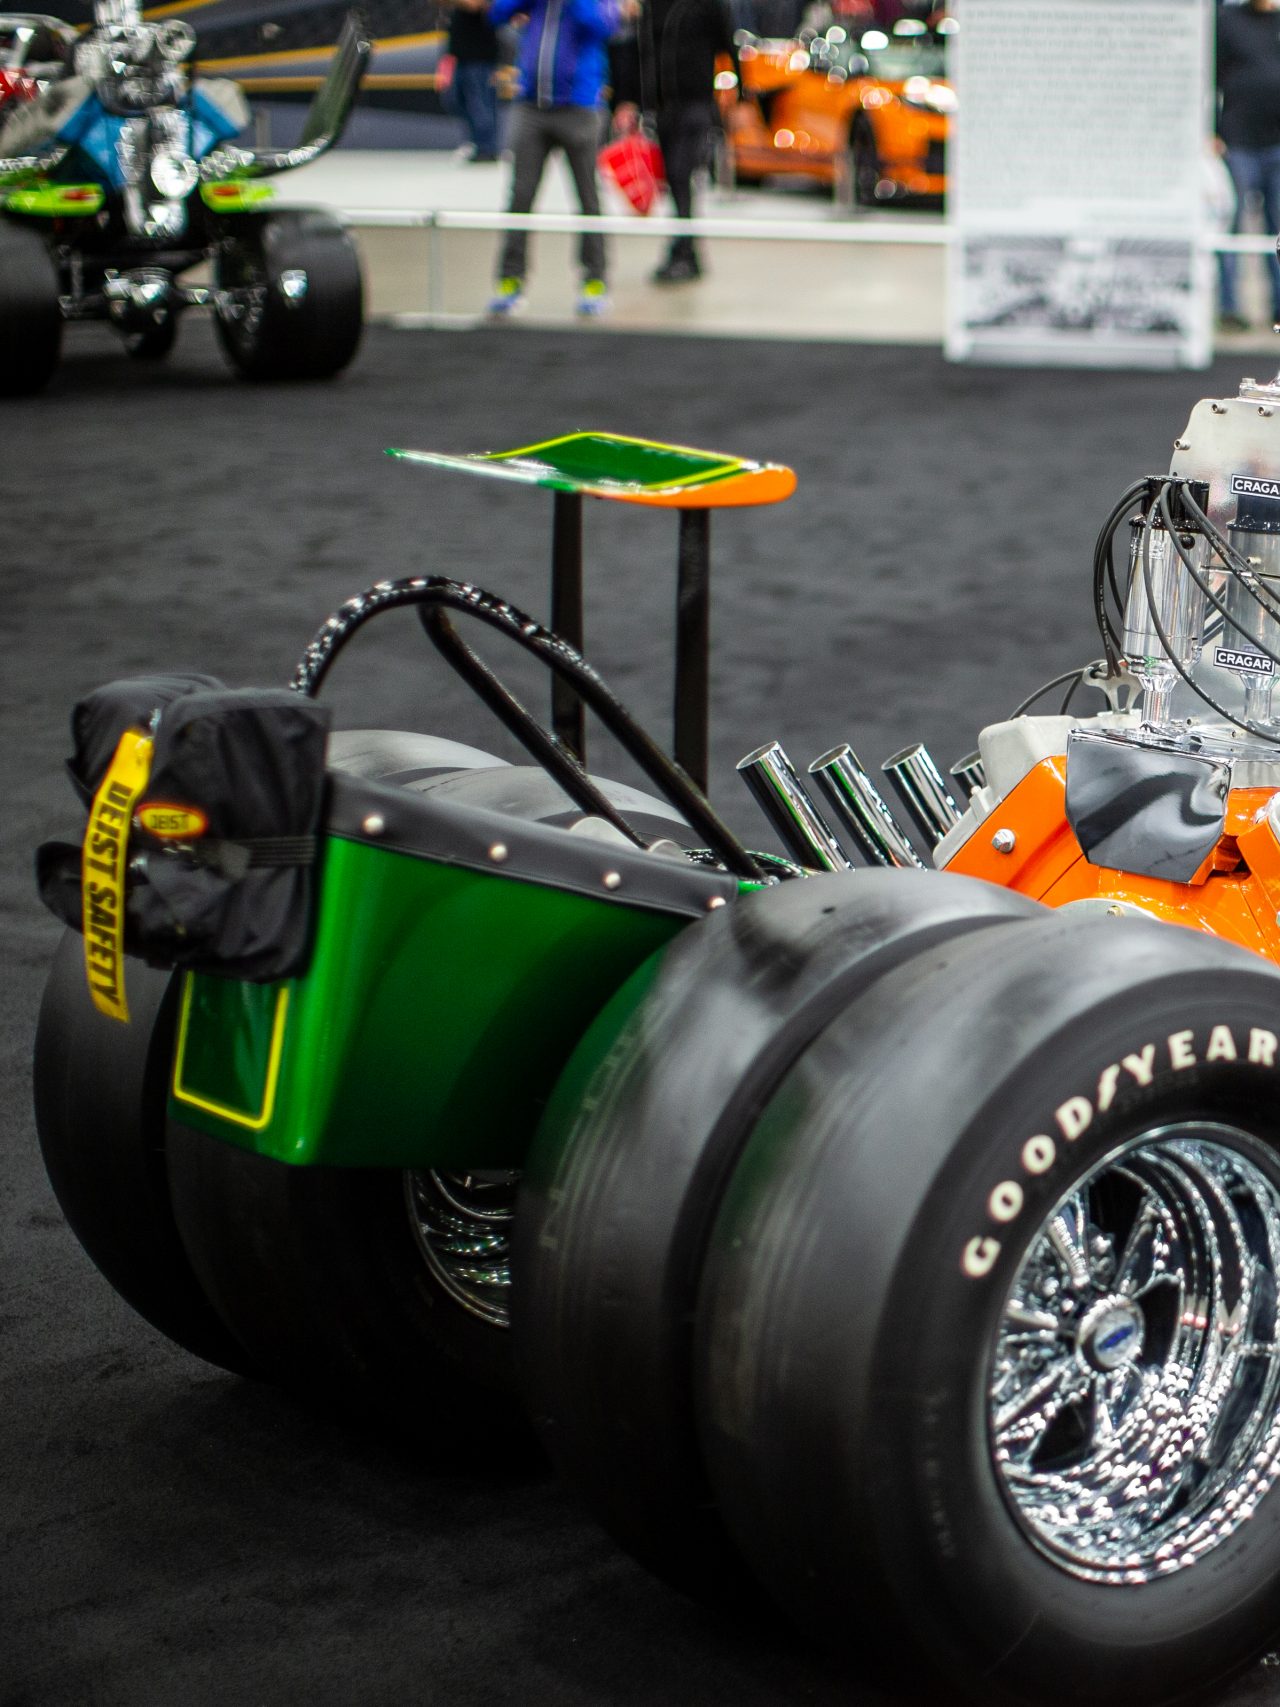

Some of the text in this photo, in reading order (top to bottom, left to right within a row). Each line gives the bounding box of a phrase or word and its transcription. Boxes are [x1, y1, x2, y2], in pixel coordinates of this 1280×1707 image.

[1217, 652, 1272, 671] CRAGAR
[87, 881, 120, 1006] SAFETY
[960, 1025, 1279, 1278] GOODYEAR
